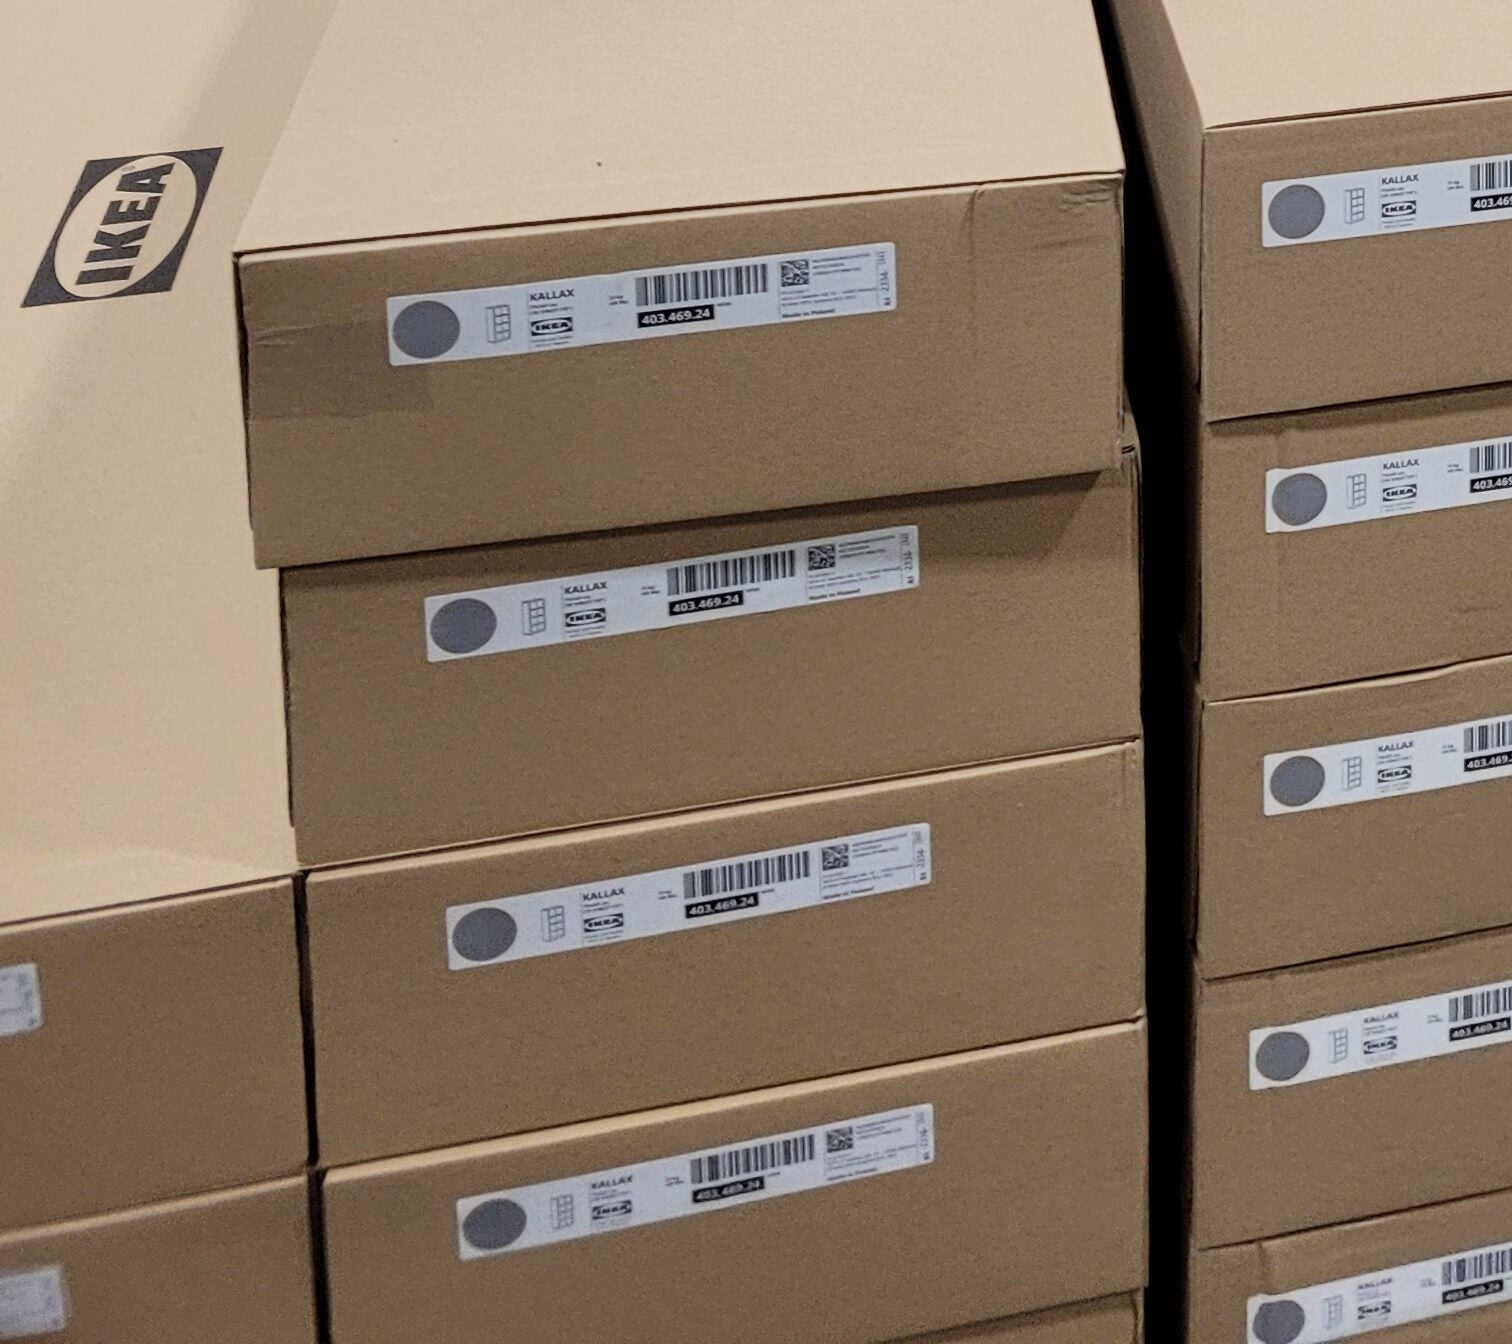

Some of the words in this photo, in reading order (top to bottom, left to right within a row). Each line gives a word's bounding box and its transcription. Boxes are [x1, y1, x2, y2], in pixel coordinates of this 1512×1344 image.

[1381, 174, 1419, 185] KALLAX
[1385, 203, 1413, 212] IKEA
[75, 163, 175, 285] IKEA
[530, 289, 575, 302] KALLAX
[641, 308, 711, 326] 403.469.24
[535, 322, 569, 331] IKEA
[1383, 458, 1420, 470] KALLAX
[564, 581, 608, 595] KALLAX
[672, 594, 740, 614] 403.469.24
[582, 887, 625, 901] KALLAX
